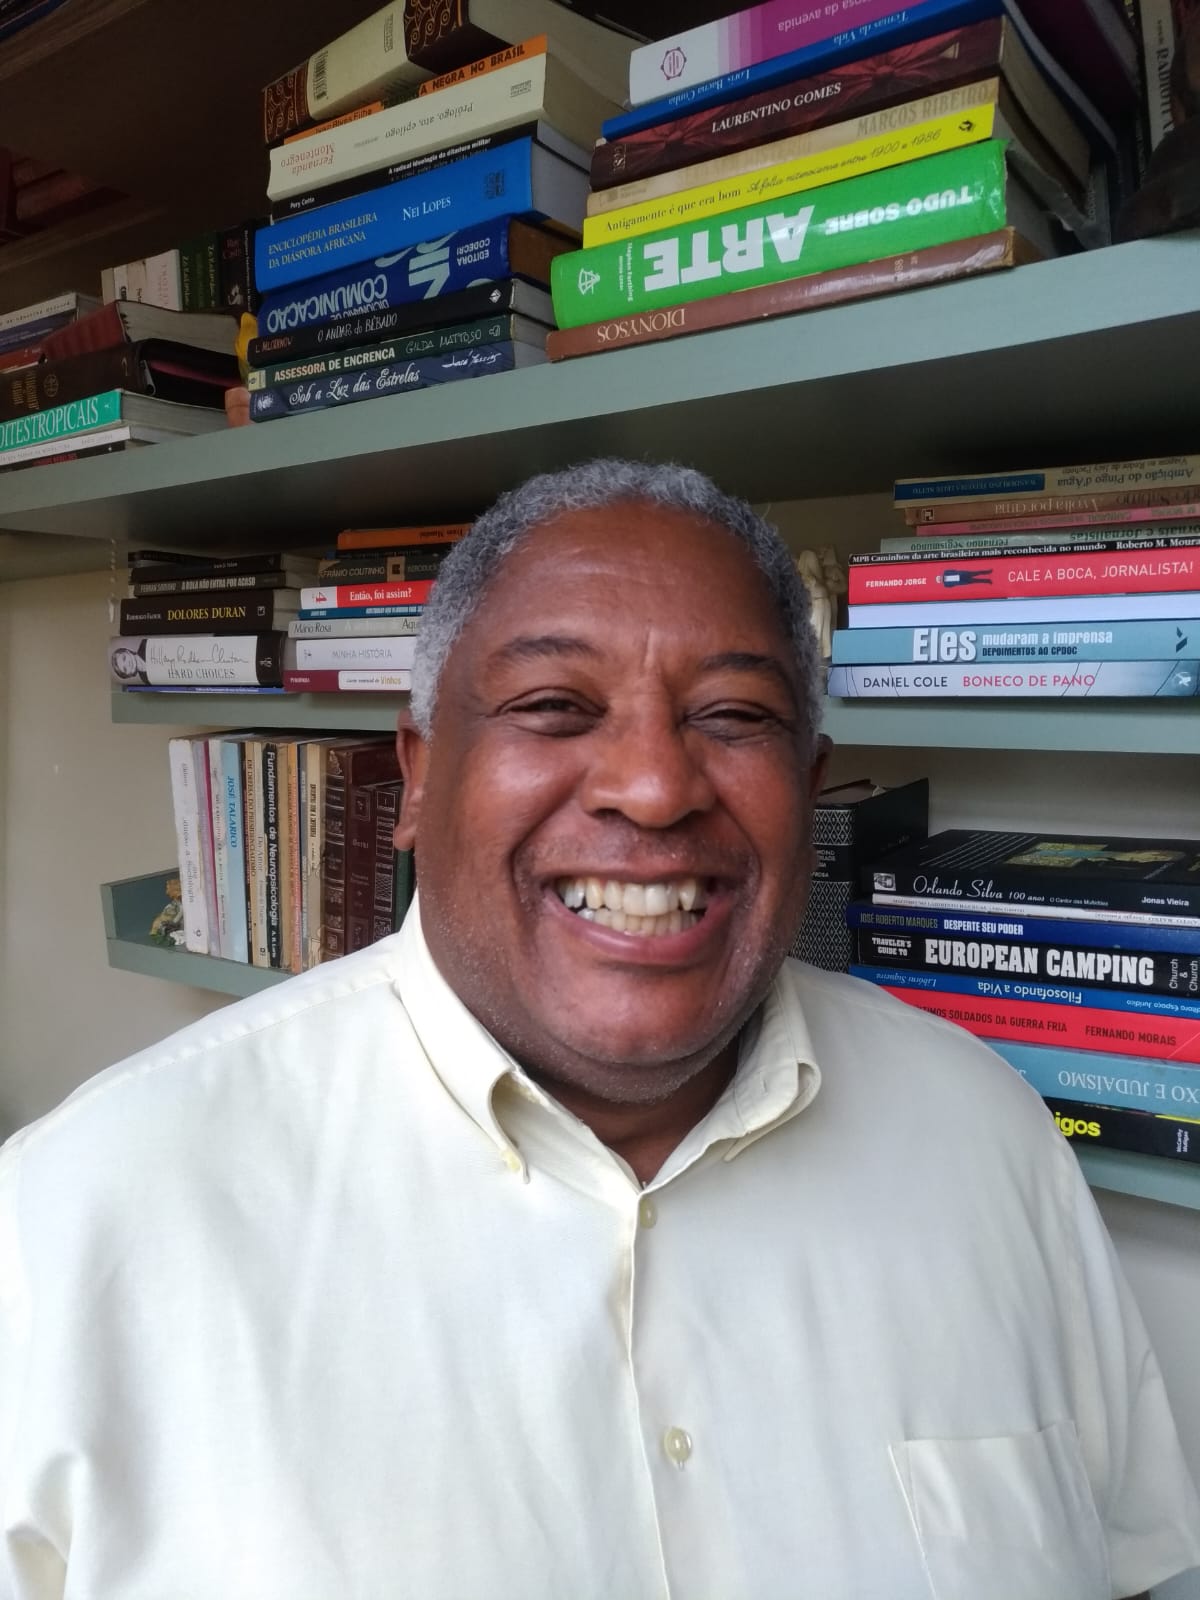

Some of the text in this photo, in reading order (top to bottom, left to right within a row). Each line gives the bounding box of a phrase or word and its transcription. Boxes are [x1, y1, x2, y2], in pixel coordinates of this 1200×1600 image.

[778, 3, 839, 32] da avenida
[859, 22, 871, 35] da
[833, 32, 856, 46] Vida
[432, 69, 465, 89] NEGRA
[470, 61, 485, 75] NO
[490, 45, 525, 67] BRASIL
[711, 82, 842, 133] LAURENTINO GOMES
[857, 84, 990, 138] MARCOS RIBEIRO
[280, 142, 336, 167] Montenegro
[291, 154, 334, 176] Fernanda
[606, 206, 666, 233] Antigamente
[677, 201, 697, 217] que
[698, 196, 716, 208] era
[718, 188, 742, 202] bom
[869, 142, 899, 159] 1900
[910, 128, 942, 147] 1986
[825, 184, 976, 235] TUDO SOBRE
[328, 212, 378, 237] BRASILEIRA
[268, 257, 281, 269] DA
[324, 231, 367, 252] AFRICANA
[457, 237, 490, 256] CODECRI
[643, 205, 815, 292] ARTE
[457, 249, 489, 267] EDITORA
[597, 309, 686, 344] DIONYSOS
[274, 329, 482, 382] ASSESSORA DE ENCRENCA GILDA MATTOSO
[289, 362, 421, 406] Sob a Luz das Estrelas
[1095, 473, 1124, 486] Pingo
[1128, 472, 1142, 482] do
[1144, 468, 1194, 481] Ambição
[1070, 528, 1143, 541] Jornalistas
[852, 536, 1200, 564] MPB Caminhos da arte brasileira mais reconhecida no mundo Roberto M. Moura
[349, 565, 385, 577] COUTINHO
[1008, 561, 1193, 583] CALE A BOCA, JORNALISTA!
[865, 577, 927, 588] FERNANDO JORGE
[350, 586, 413, 605] Então, foi assim?
[167, 606, 247, 621] DOLORES DURAN
[315, 621, 331, 633] Rosa
[912, 627, 1113, 662] Eles mudaram a imprensa
[982, 645, 1078, 657] DEPOIMENTOS AO CPDOC
[332, 648, 392, 661] MINHA HISTÓRIA
[168, 668, 236, 680] HARD CHOICES
[863, 675, 1096, 689] DANIEL COLE BONECO DE PANO
[247, 759, 254, 769] EM
[247, 771, 255, 796] DEFESA
[266, 752, 278, 823] Fundamentos
[227, 775, 238, 849] JOSÉ TALARICO
[249, 798, 255, 810] DO
[257, 836, 264, 849] Do
[269, 826, 278, 840] de
[249, 811, 258, 877] PRESIDENCIALISMO
[268, 843, 279, 926] Neuropsicologia
[913, 875, 963, 897] Orlando
[967, 879, 1003, 899] Silva
[1009, 891, 1026, 901] 100
[1142, 896, 1190, 908] Jonas Vieira
[860, 911, 1024, 936] JOSÉ ROBERTO MARQUES DESPERTE SEU PODER
[872, 936, 912, 949] TRAVELER'S
[878, 946, 908, 957] GUIDE TO
[925, 938, 1154, 986] EUROPEAN CAMPING
[1169, 958, 1178, 989] Church
[1180, 971, 1188, 979] &
[1189, 960, 1198, 991] Church
[977, 981, 1003, 995] Vida
[1004, 984, 1011, 993] a
[1014, 985, 1082, 1004] Filosofando
[1154, 1001, 1179, 1012] Espaço
[1180, 1004, 1200, 1015] ditora
[919, 1006, 1177, 1047] TIMOS SOLDADOS DA GUERRA FRIA FERNANDO MORAIS
[1058, 1070, 1150, 1097] JUDAÍSMO
[1154, 1083, 1166, 1099] E
